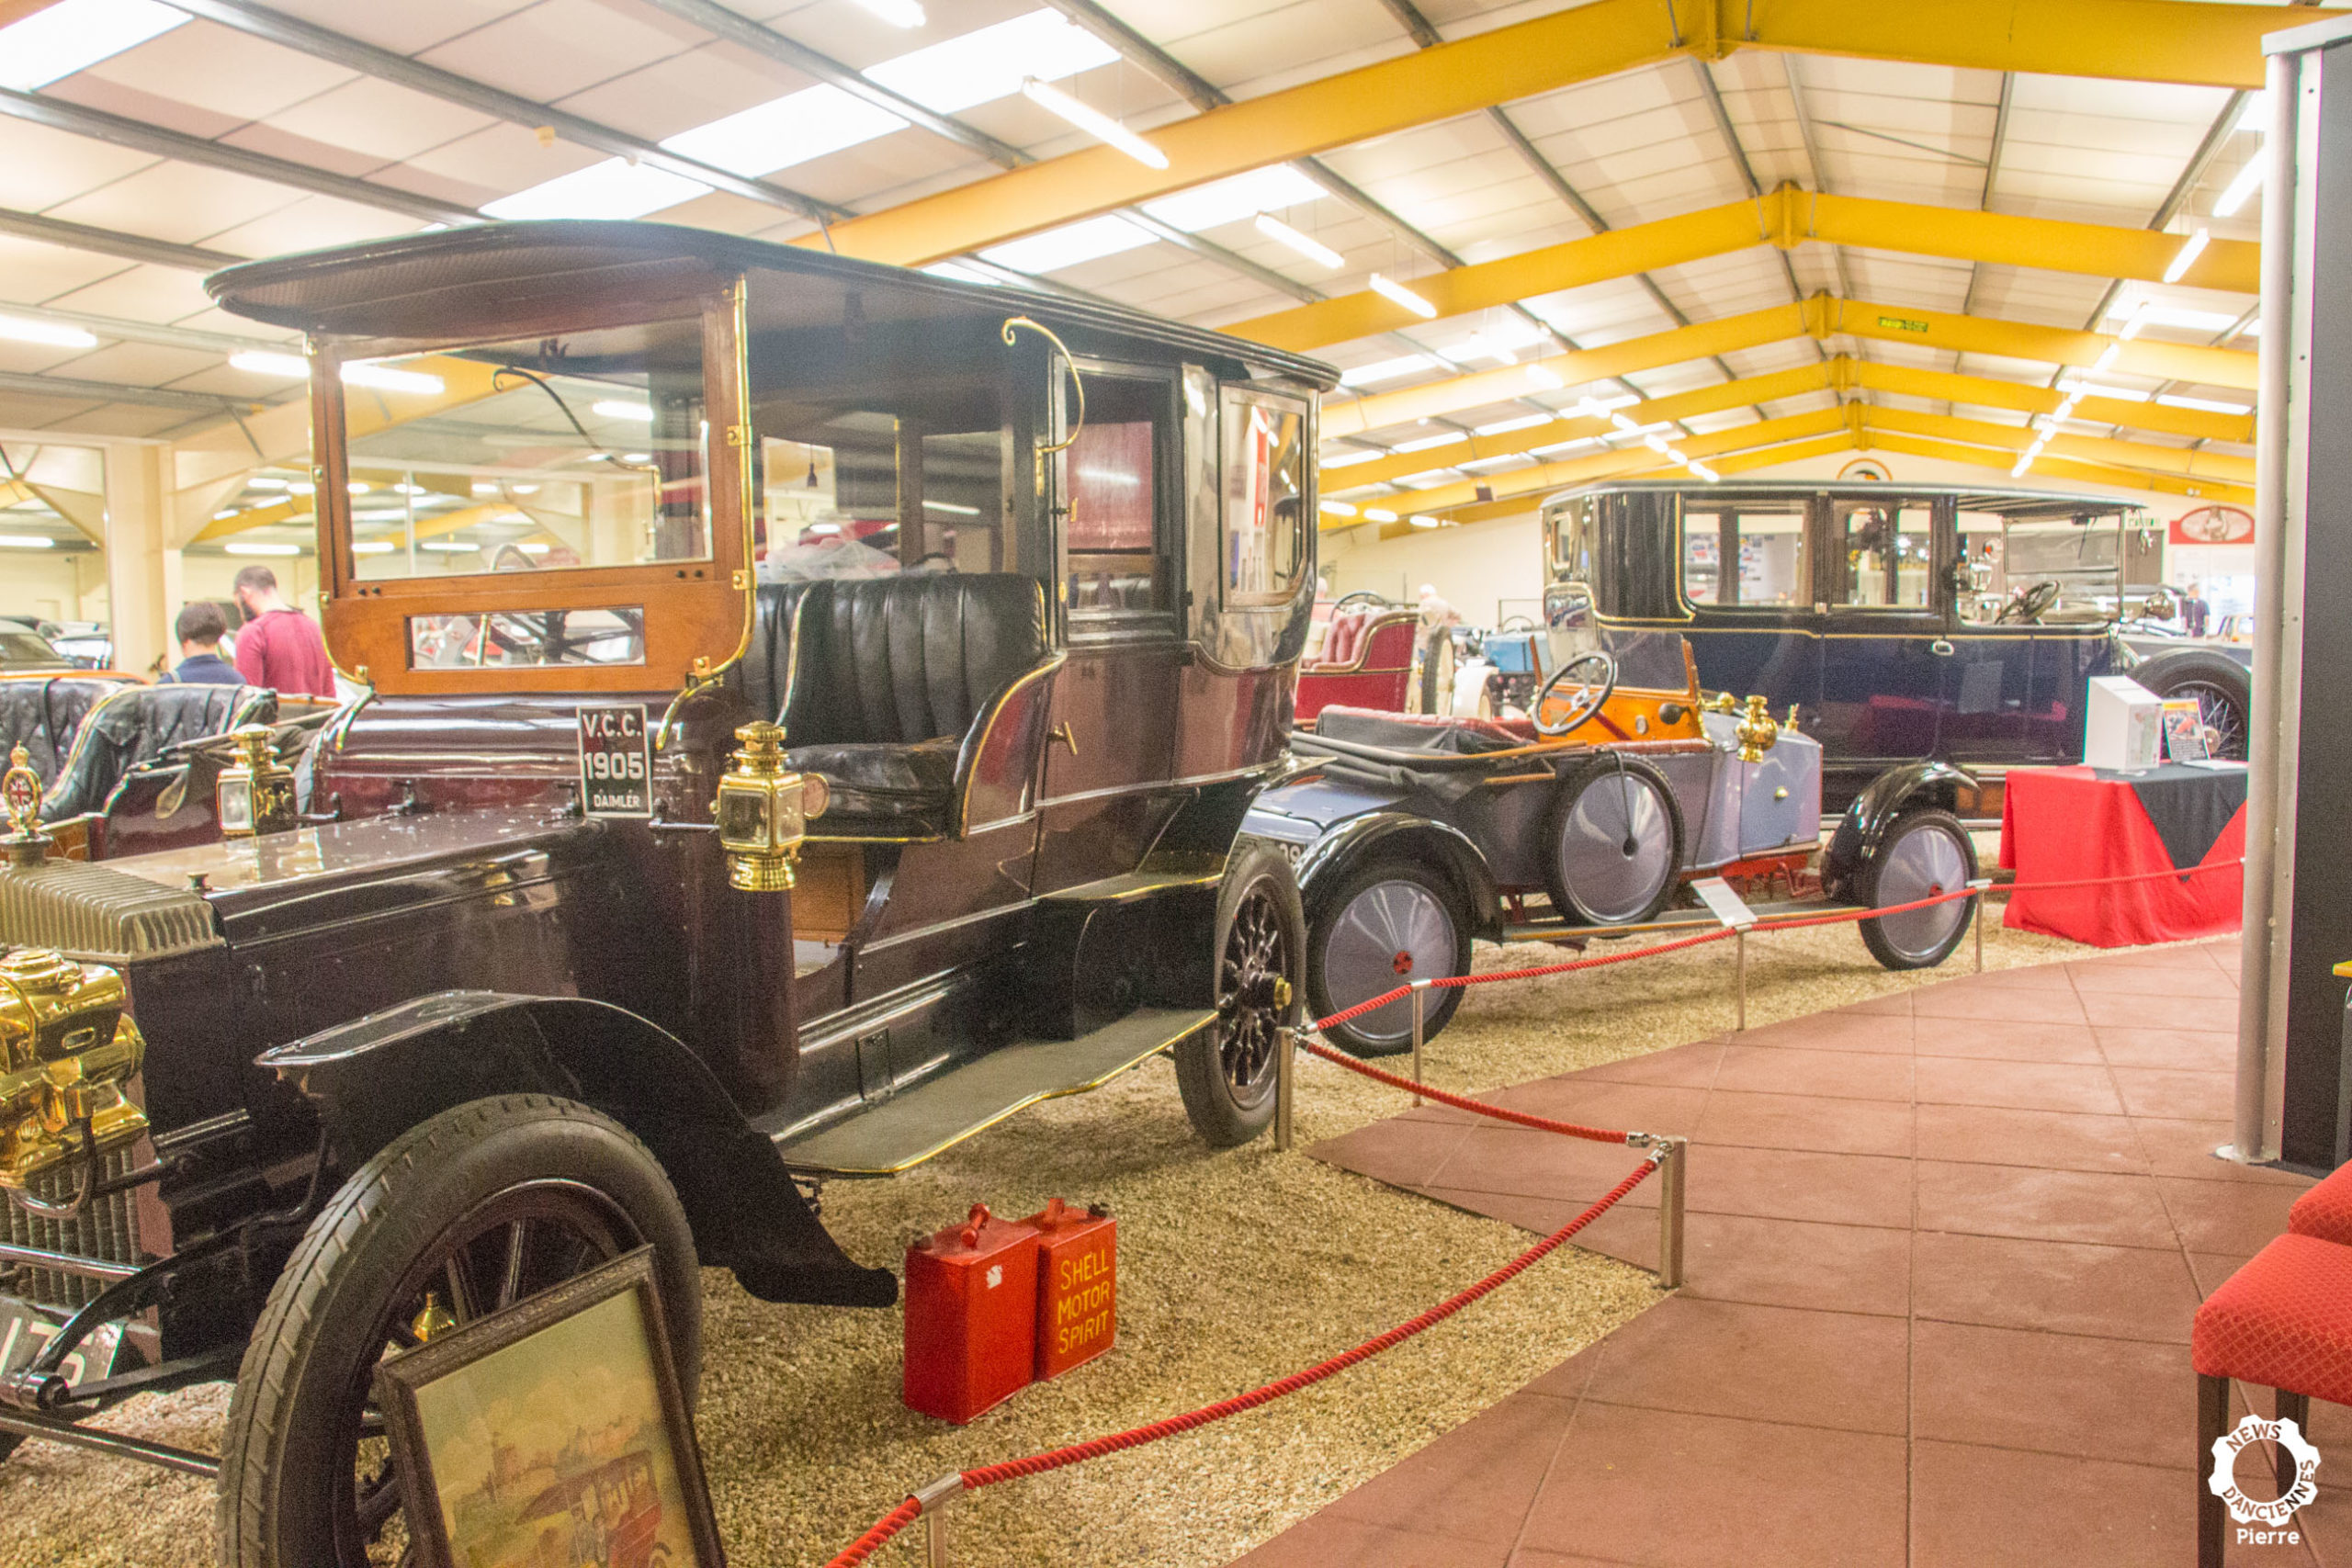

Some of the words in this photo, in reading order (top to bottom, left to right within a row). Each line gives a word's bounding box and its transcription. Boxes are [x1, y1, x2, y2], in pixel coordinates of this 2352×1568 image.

[582, 714, 642, 738] V.C.C.
[583, 752, 645, 780] 1905
[594, 795, 640, 808] DAIMLER
[1060, 1249, 1110, 1291] SHELL
[1057, 1280, 1110, 1325] MOTOR
[1058, 1310, 1110, 1354] SPIRIT
